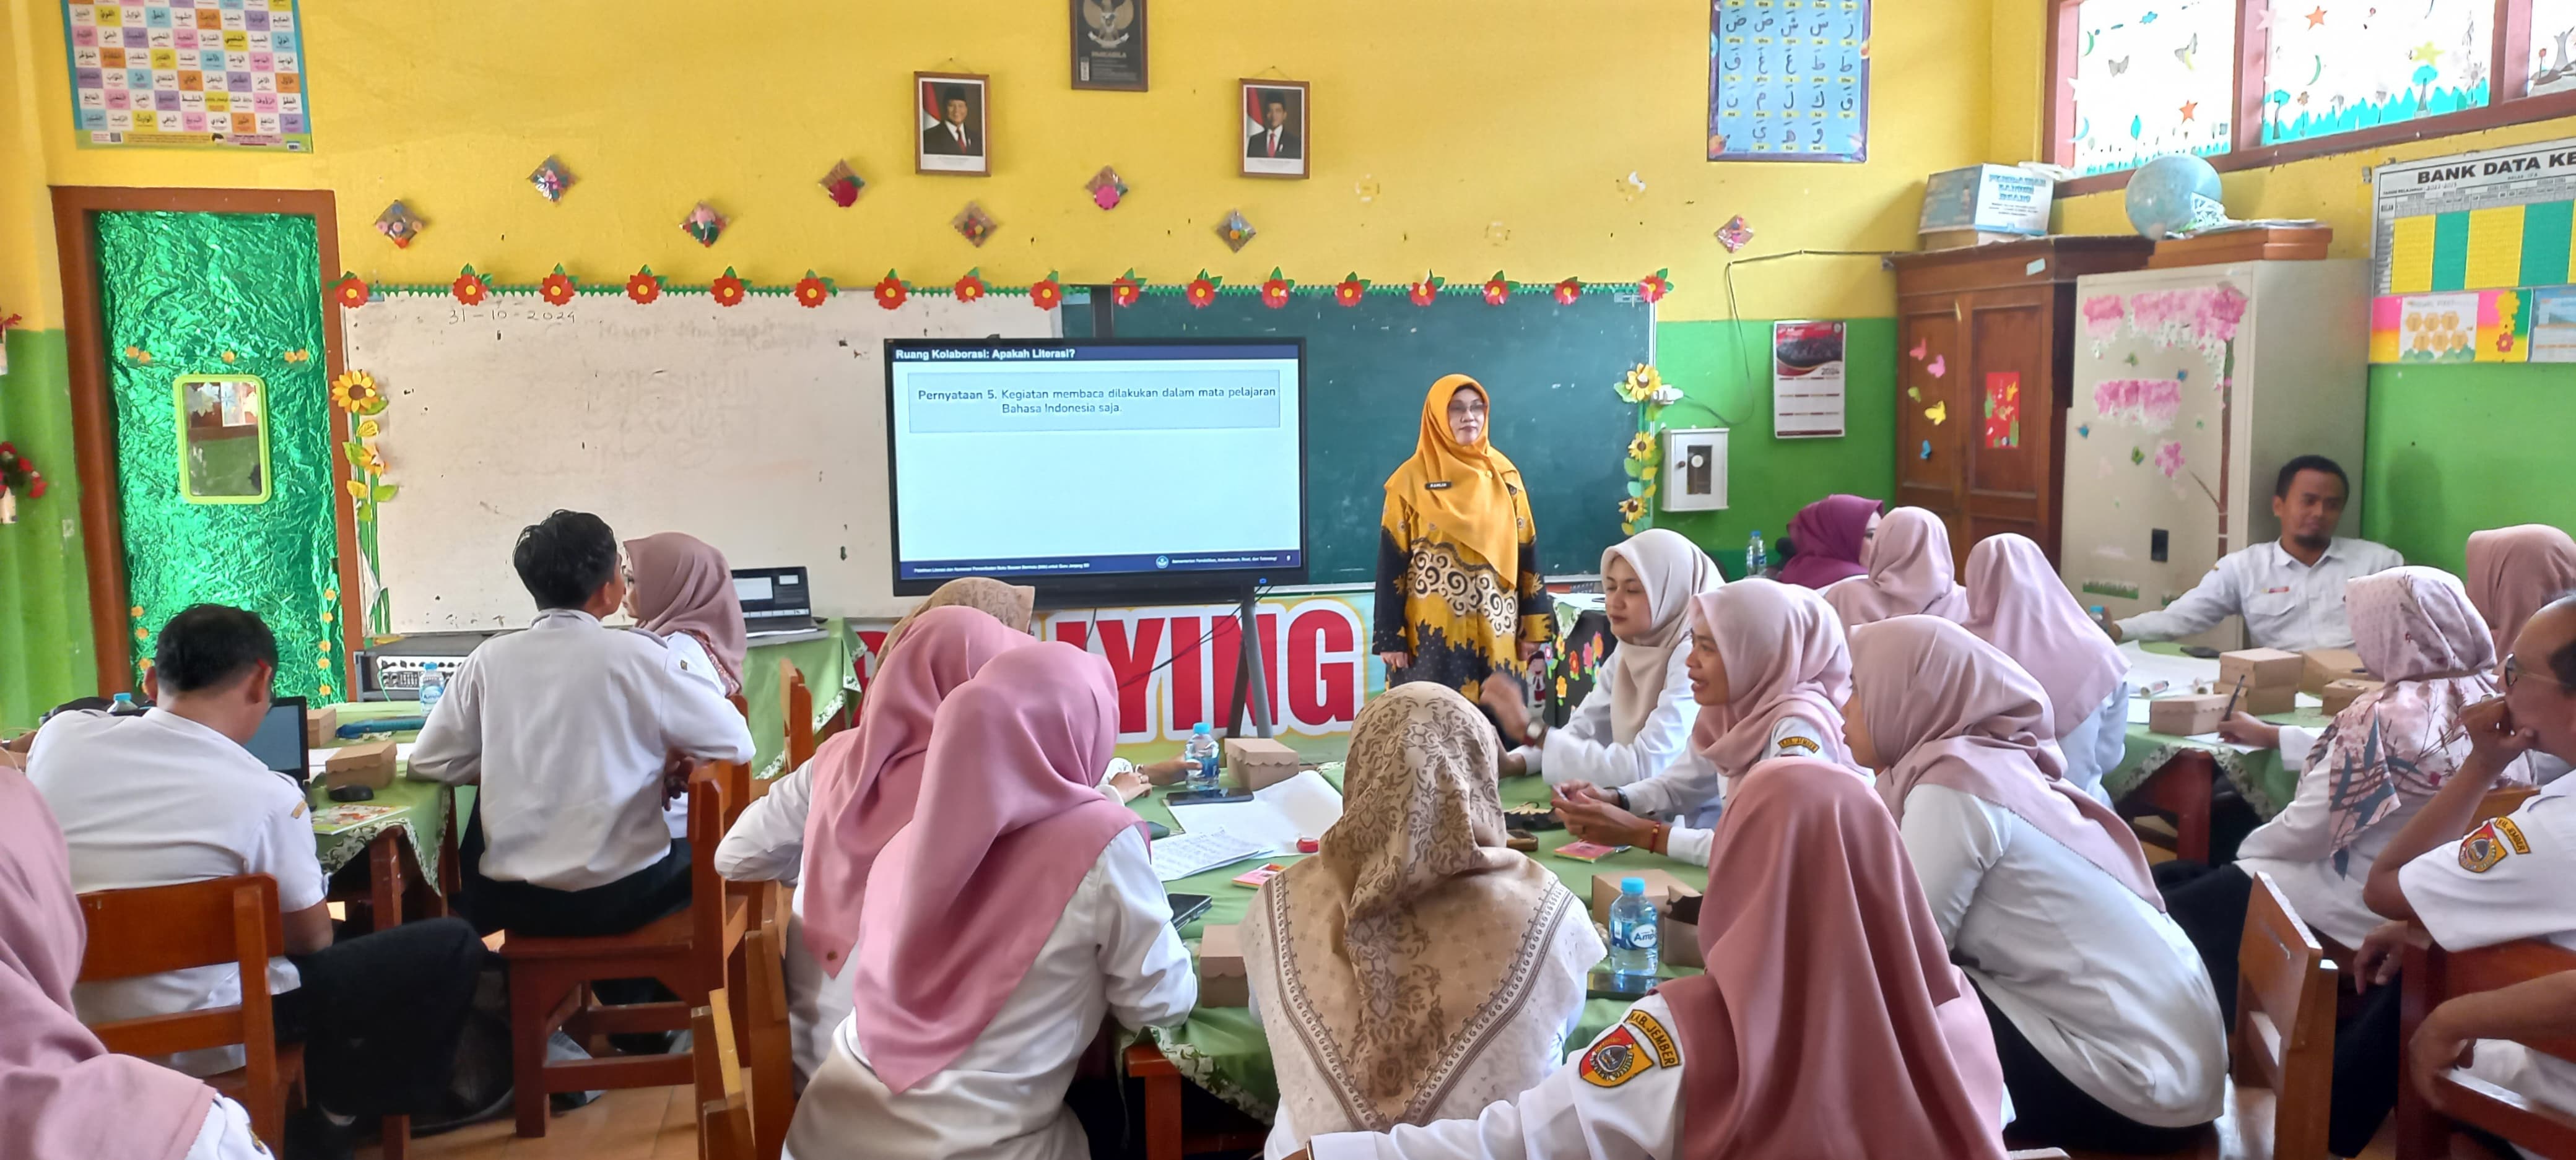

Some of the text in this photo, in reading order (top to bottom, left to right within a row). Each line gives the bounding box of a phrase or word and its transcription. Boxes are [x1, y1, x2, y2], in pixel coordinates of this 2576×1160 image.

[2417, 164, 2476, 184] BANK
[2483, 157, 2541, 176] DATA
[895, 348, 1076, 360] Ruang Kolaborasi: Apakah Literasi?
[918, 386, 1276, 402] Pernyataan 5. Kegiatan membaca dilakukan dalam mata pelajaran
[1002, 403, 1122, 414] Bahasa Indonesia saja.
[1647, 1026, 1676, 1065] JEMBER
